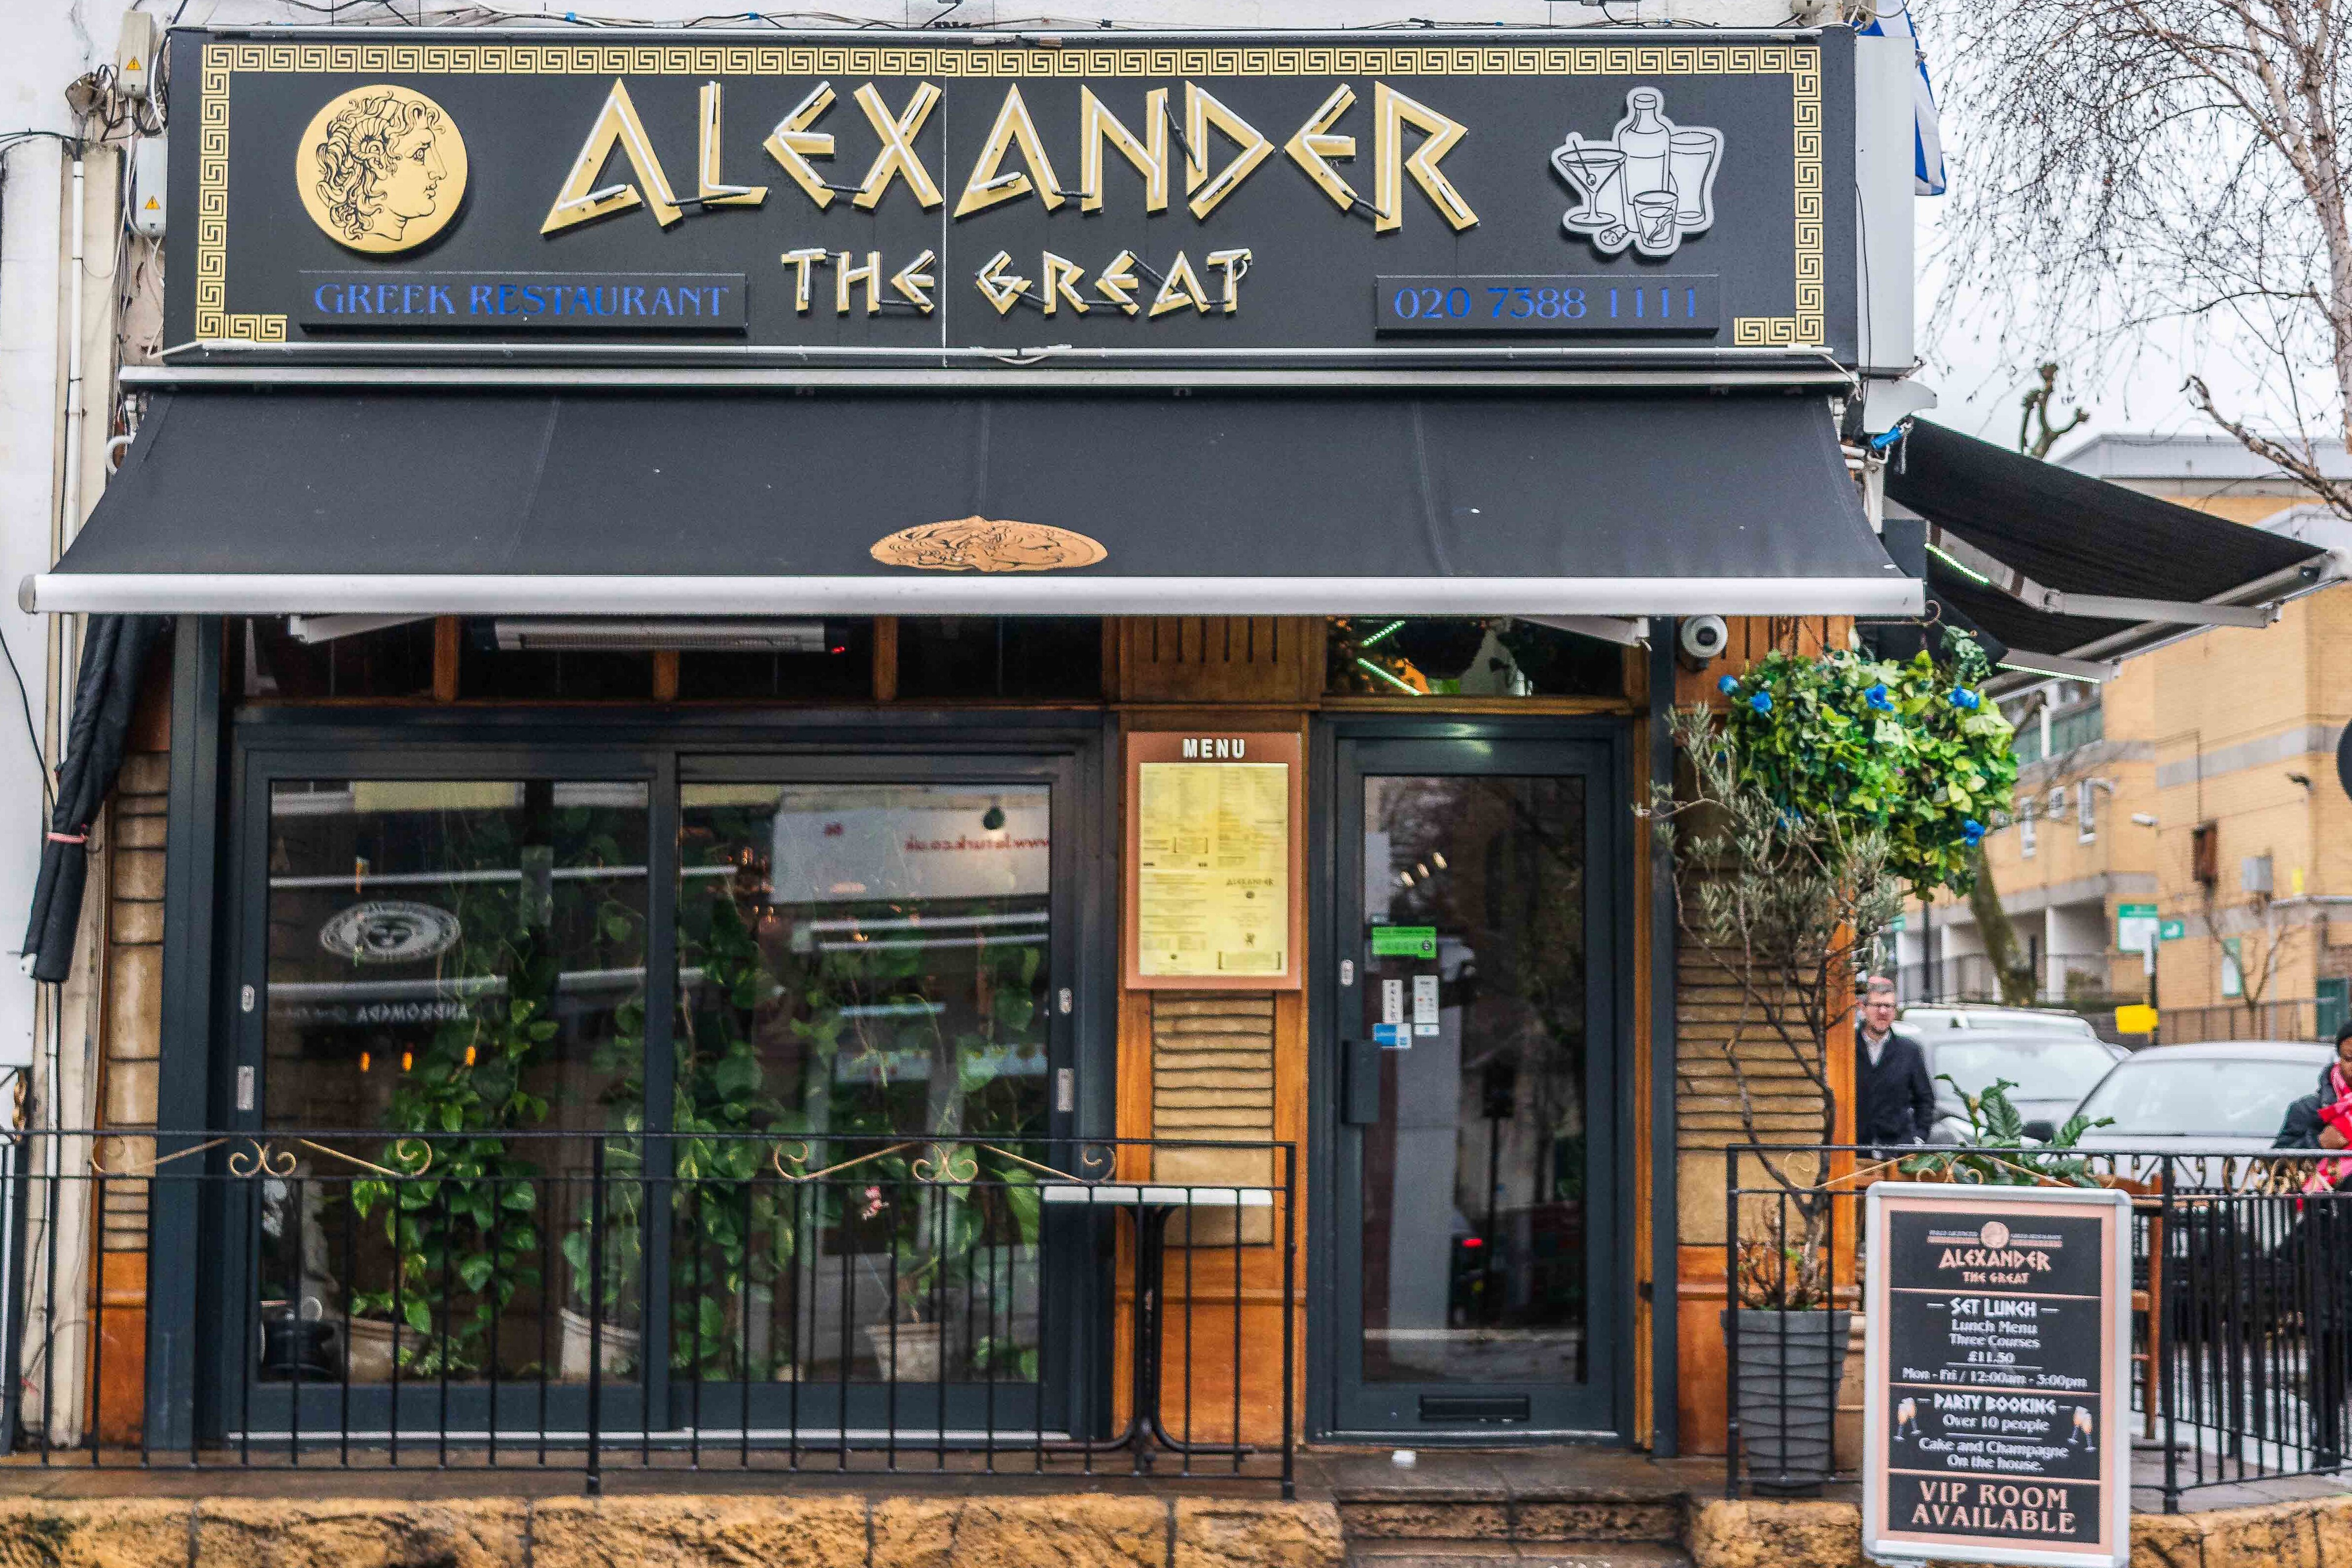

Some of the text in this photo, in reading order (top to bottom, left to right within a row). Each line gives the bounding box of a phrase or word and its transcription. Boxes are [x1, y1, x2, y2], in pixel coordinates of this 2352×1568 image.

[540, 76, 1480, 235] ALEXANDER
[782, 248, 1251, 316] THE GREAT
[314, 283, 729, 316] GREEK RESTAURANT
[1393, 287, 1471, 319] 020
[1487, 287, 1587, 319] 7388
[1182, 738, 1246, 759] MENU
[1938, 1248, 2052, 1272] ALEXANDER
[1962, 1272, 2031, 1284] THE GREAT
[1950, 1297, 2037, 1318] SET LUNCH
[1951, 1319, 2038, 1335] Lunch Menu
[1949, 1333, 2041, 1349] Three Courses
[1967, 1350, 2016, 1364] £11.50
[1902, 1367, 1930, 1381] Mon
[1939, 1369, 1958, 1382] Fri
[1933, 1393, 2057, 1415] PARTY BOOKING
[1942, 1414, 2050, 1434] Over 10 people
[1918, 1437, 2070, 1460] Cake and Champagne
[1946, 1454, 2045, 1473] On the house
[1919, 1480, 2068, 1510] VIP ROOM
[1911, 1503, 2077, 1534] AVAILABLE
